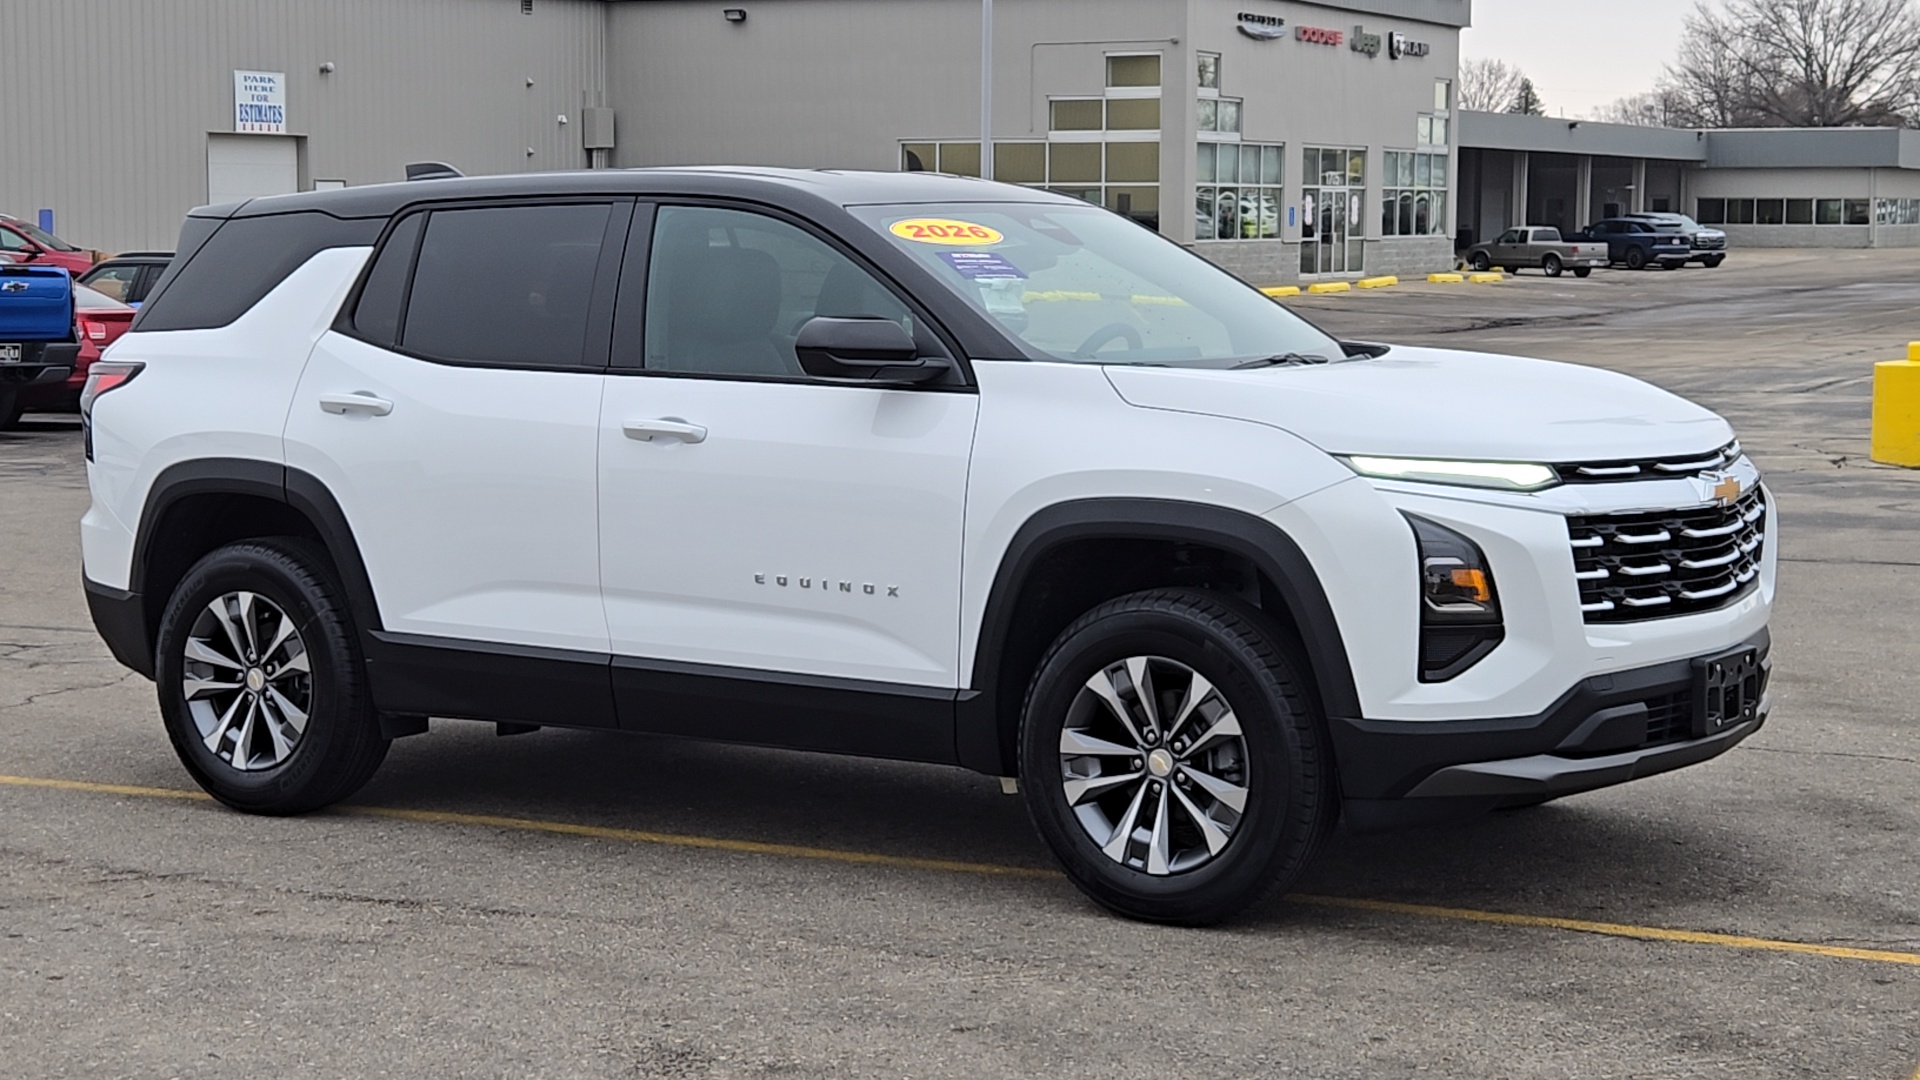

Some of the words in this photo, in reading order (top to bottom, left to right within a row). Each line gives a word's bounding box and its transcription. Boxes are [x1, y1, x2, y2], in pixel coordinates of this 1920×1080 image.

[1298, 26, 1343, 46] DODGE
[1351, 25, 1381, 58] Jeep
[243, 74, 276, 84] PARK
[244, 84, 276, 94] HERE
[251, 93, 269, 103] FOR
[239, 103, 283, 124] ESTIMATES
[905, 224, 989, 239] 2026
[754, 572, 899, 598] EQUINOX
